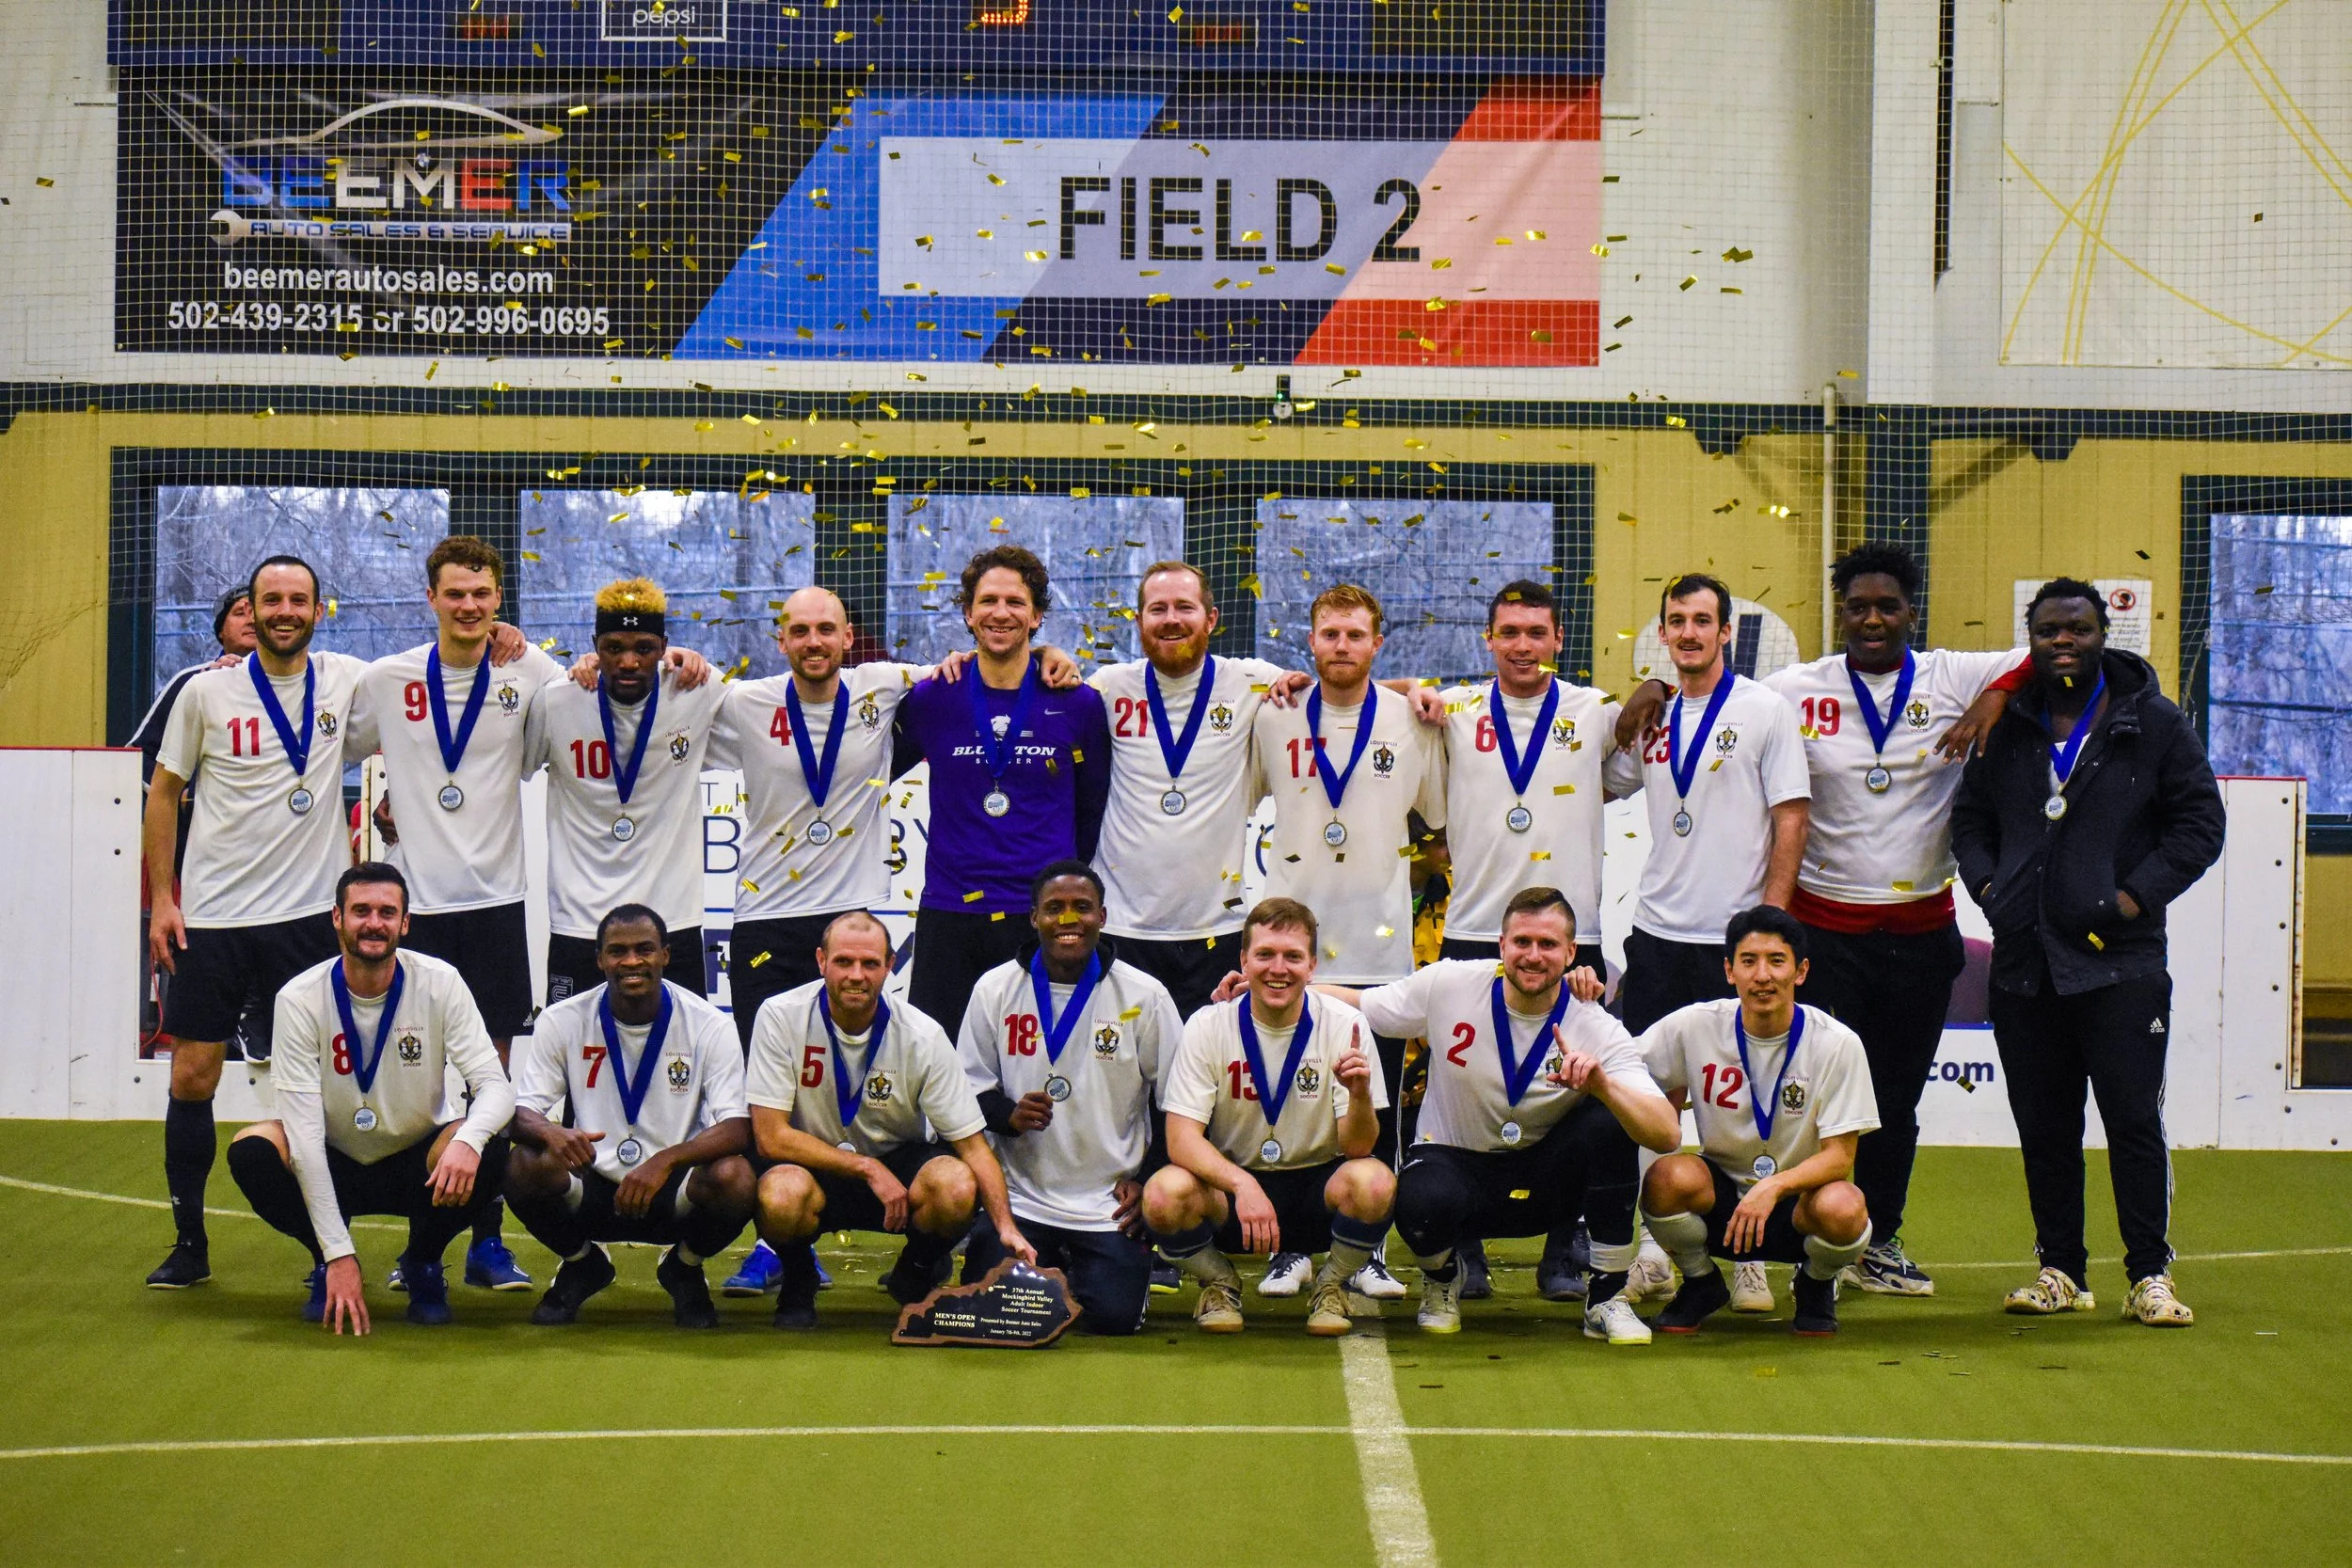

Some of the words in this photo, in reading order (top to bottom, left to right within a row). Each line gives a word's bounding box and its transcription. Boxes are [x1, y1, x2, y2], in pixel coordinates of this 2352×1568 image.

[632, 6, 695, 27] pepsi
[223, 158, 571, 210] BEEMER
[250, 222, 323, 237] AUTO
[329, 222, 421, 239] SALES
[428, 223, 445, 239] &
[452, 224, 568, 240] SERVICE
[1060, 177, 1338, 261] FIELD
[1372, 178, 1421, 261] 2
[225, 261, 553, 293] beemerautosales.com
[168, 301, 363, 332] 502-439-2315
[373, 310, 404, 333] or
[414, 304, 610, 336] 502-996-0695
[405, 681, 427, 721] 9
[1115, 697, 1148, 737] 21
[1802, 697, 1840, 736] 19
[227, 718, 260, 756] 11
[770, 707, 792, 746] 4
[1475, 715, 1498, 752] 6
[1642, 724, 1671, 765] 23
[570, 739, 611, 779] 10
[952, 746, 1056, 756] BLUTON
[1287, 737, 1327, 779] 17
[332, 1033, 354, 1075] 8
[1005, 1014, 1038, 1056] 18
[1447, 1022, 1475, 1068] 2
[582, 1046, 607, 1088] 7
[801, 1046, 826, 1088] 5
[1228, 1061, 1261, 1101] 13
[1702, 1063, 1743, 1109] 12
[934, 1320, 976, 1328] CHAMPIONS
